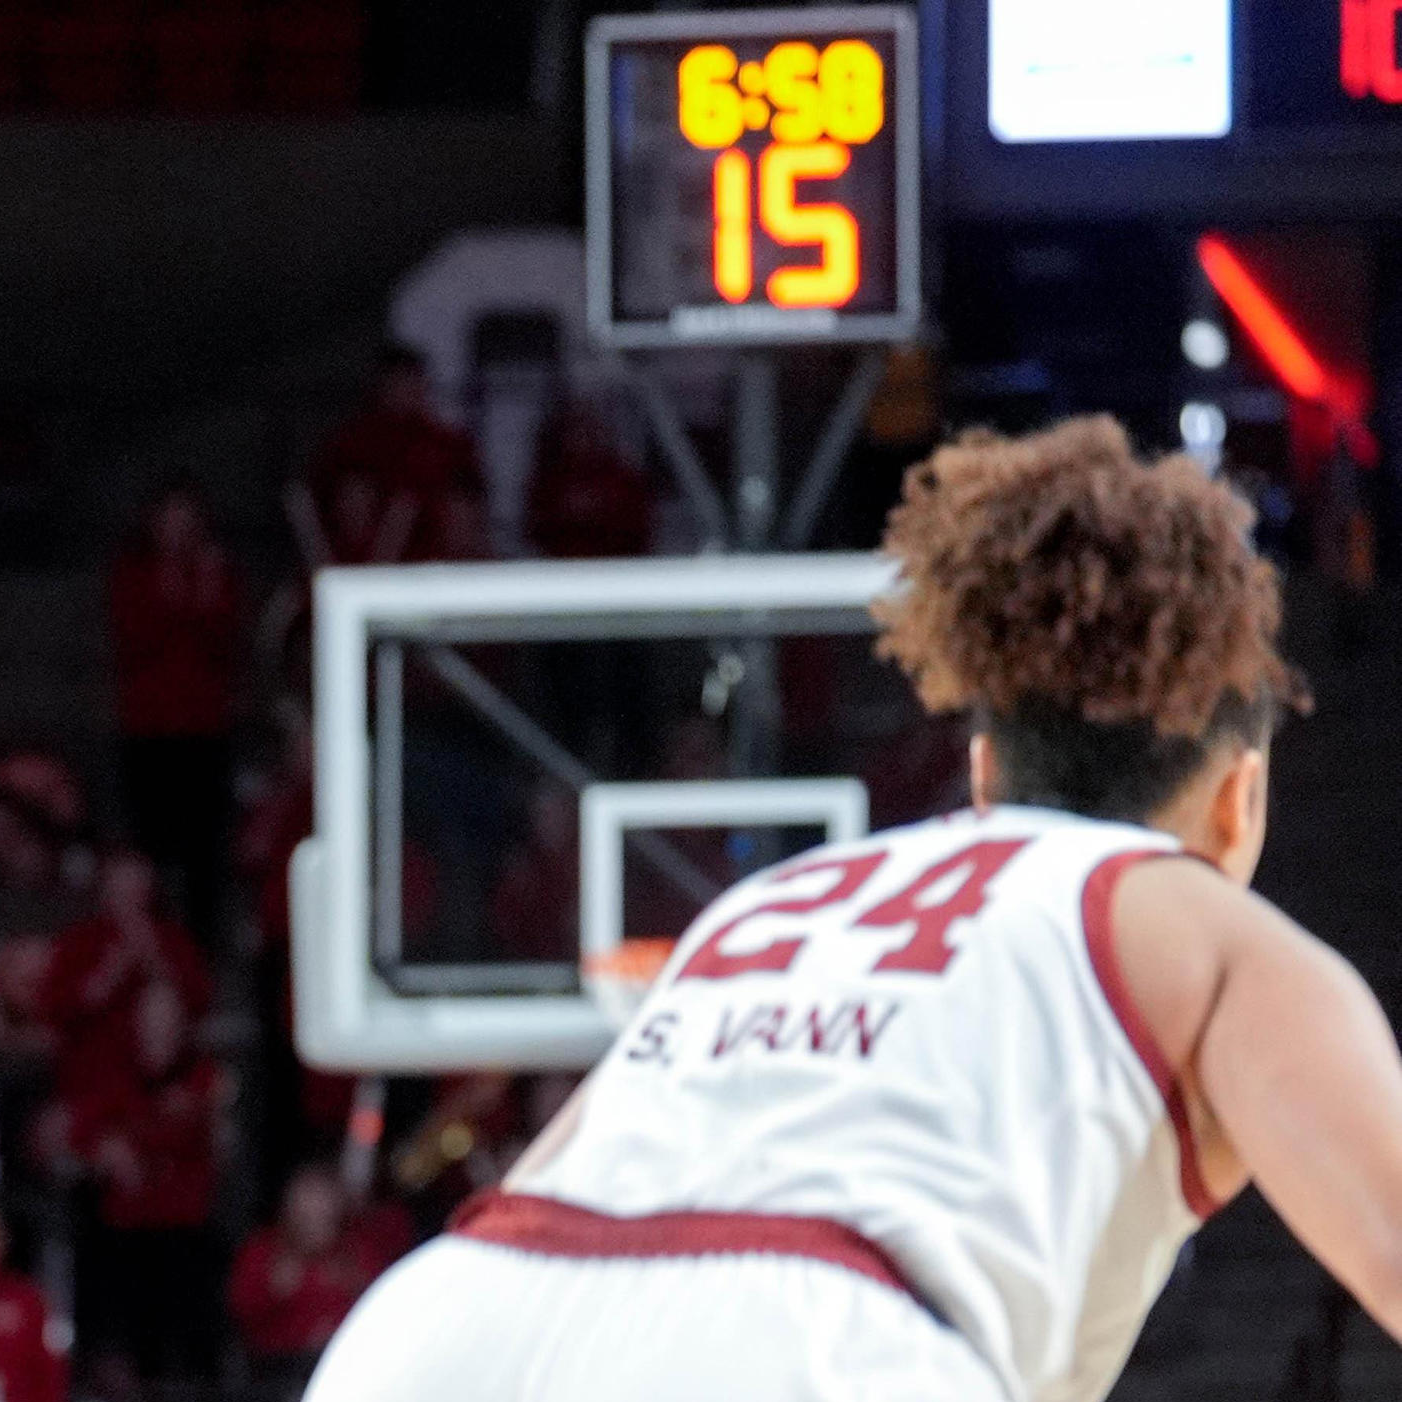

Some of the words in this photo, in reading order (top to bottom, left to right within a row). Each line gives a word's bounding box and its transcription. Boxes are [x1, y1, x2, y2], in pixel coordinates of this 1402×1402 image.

[713, 142, 862, 310] 15
[676, 837, 1038, 982] 24
[707, 1001, 900, 1061] VANN
